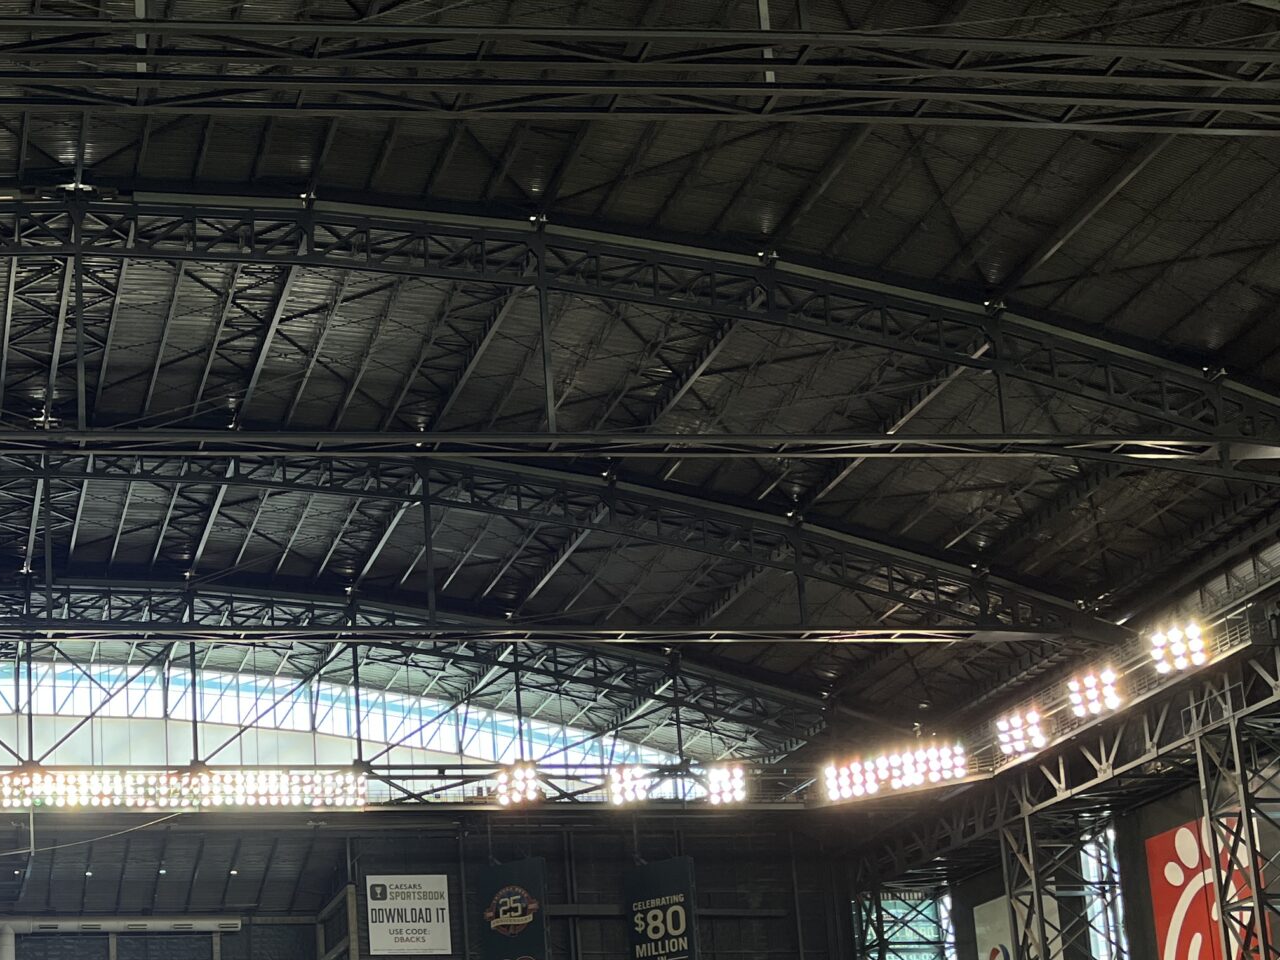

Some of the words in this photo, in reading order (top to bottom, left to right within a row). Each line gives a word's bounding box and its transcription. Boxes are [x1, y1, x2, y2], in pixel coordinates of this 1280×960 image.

[388, 891, 446, 900] SPORTSBOOK
[632, 893, 685, 911] CELEBRATING
[370, 907, 432, 923] DOWNLOAD
[436, 907, 446, 923] IT
[633, 904, 687, 940] $80
[635, 937, 688, 959] MILLION
